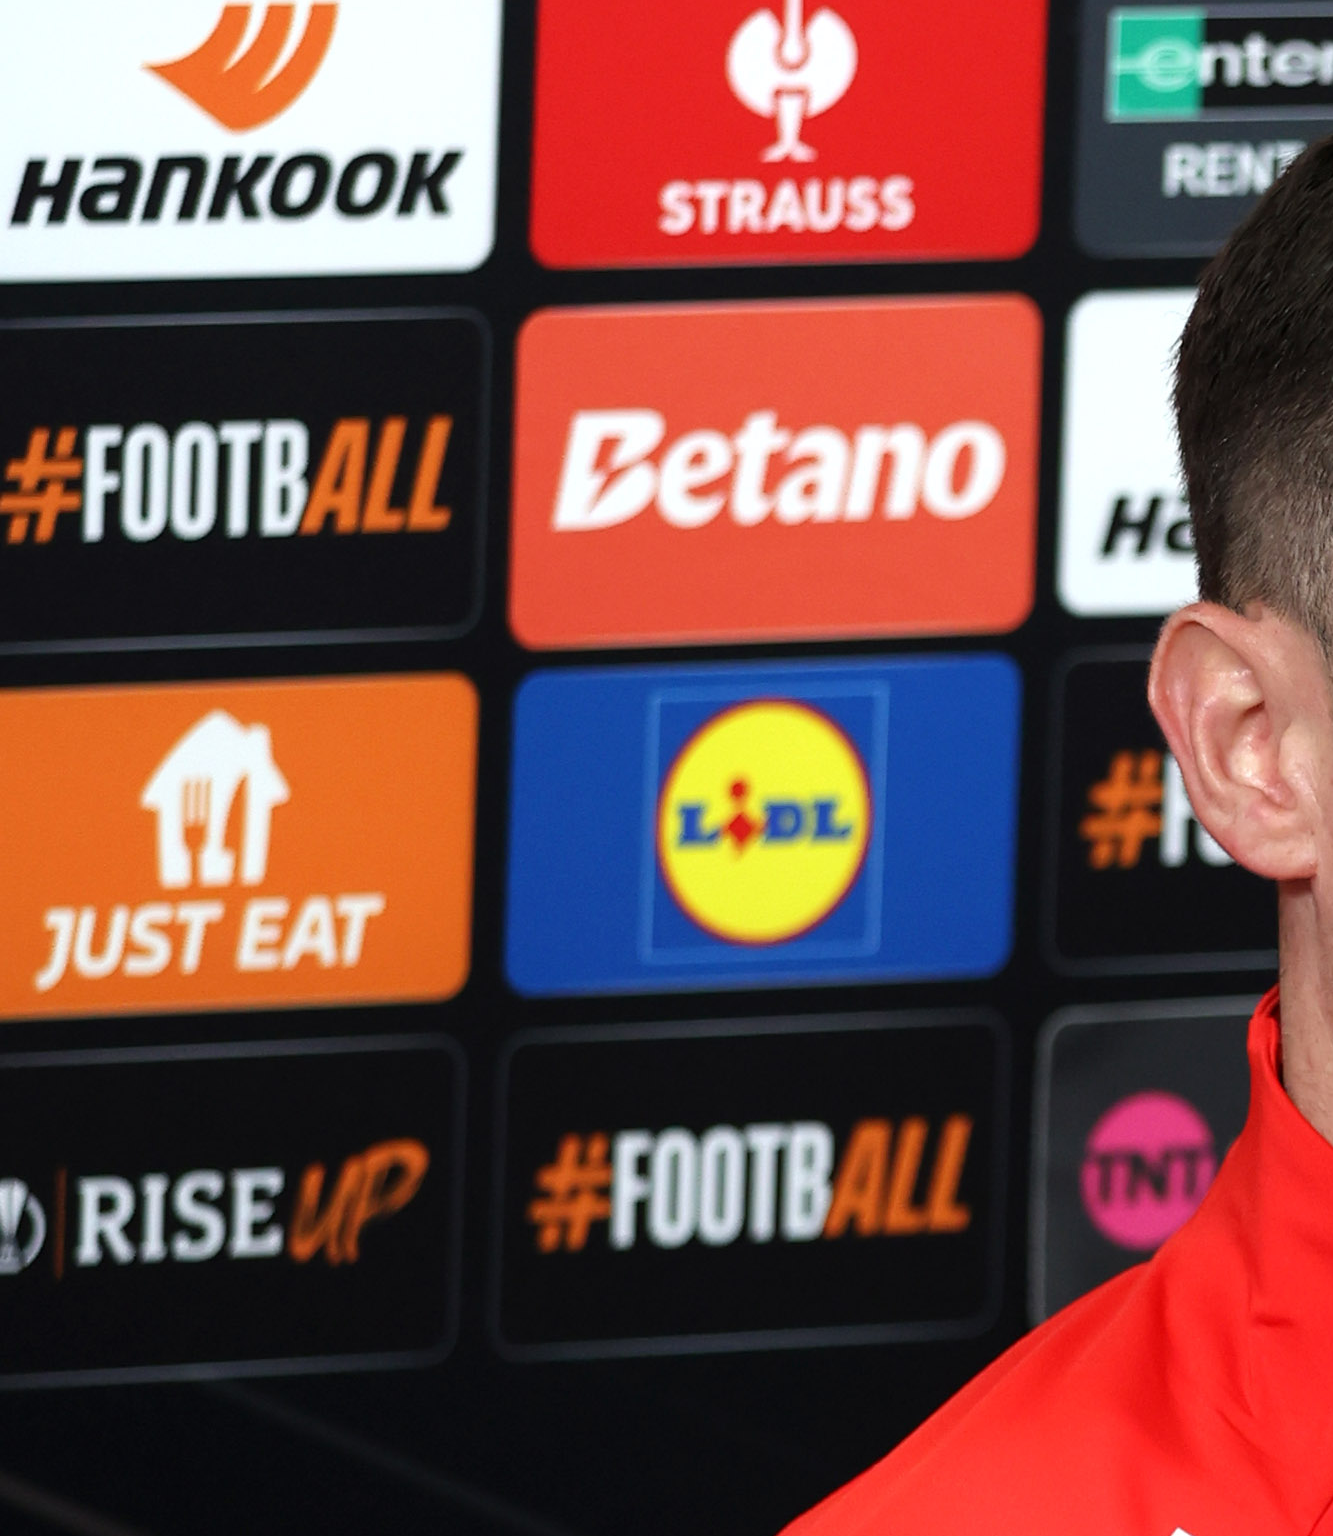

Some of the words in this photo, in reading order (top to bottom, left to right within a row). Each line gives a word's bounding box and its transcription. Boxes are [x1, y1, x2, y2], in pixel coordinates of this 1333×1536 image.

[659, 175, 915, 236] STRAUSS
[0, 416, 453, 544] #FOOTBALL
[552, 408, 1007, 532] Betano
[35, 900, 225, 992] JUST
[236, 893, 386, 971] EAT
[529, 1116, 972, 1251] #FOOTBALL
